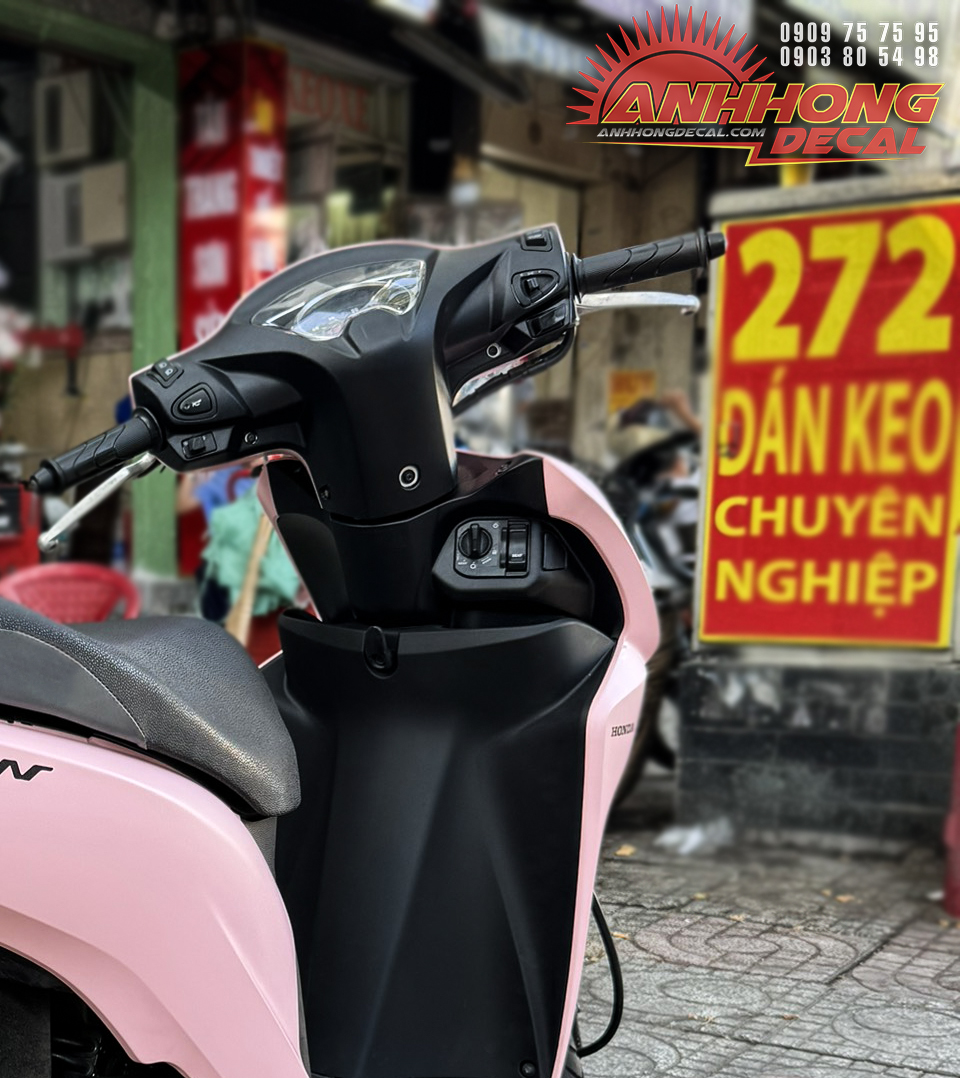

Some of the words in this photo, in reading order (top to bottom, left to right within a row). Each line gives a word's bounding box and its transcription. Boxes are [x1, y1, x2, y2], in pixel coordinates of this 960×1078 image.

[732, 214, 955, 363] 272
[718, 366, 830, 476] DÁN
[842, 379, 952, 474] KEO
[715, 484, 943, 537] CHUYÊN
[716, 550, 938, 619] NGHIỆP
